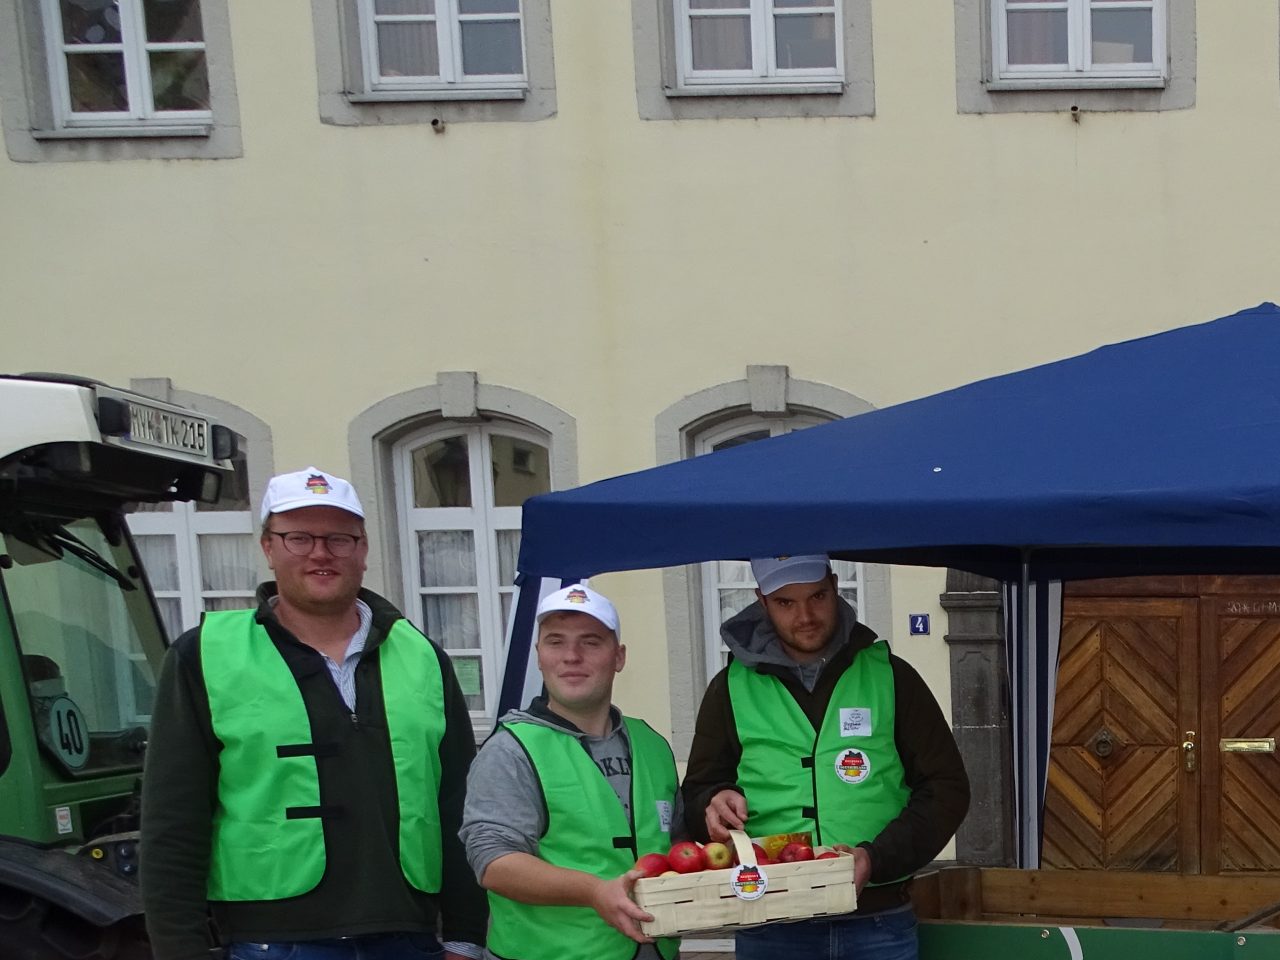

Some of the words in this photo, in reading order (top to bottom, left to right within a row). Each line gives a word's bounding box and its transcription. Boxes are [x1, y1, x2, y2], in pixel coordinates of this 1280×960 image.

[163, 415, 179, 446] TK
[181, 419, 205, 451] 215
[915, 616, 924, 632] 4
[56, 709, 84, 756] 40
